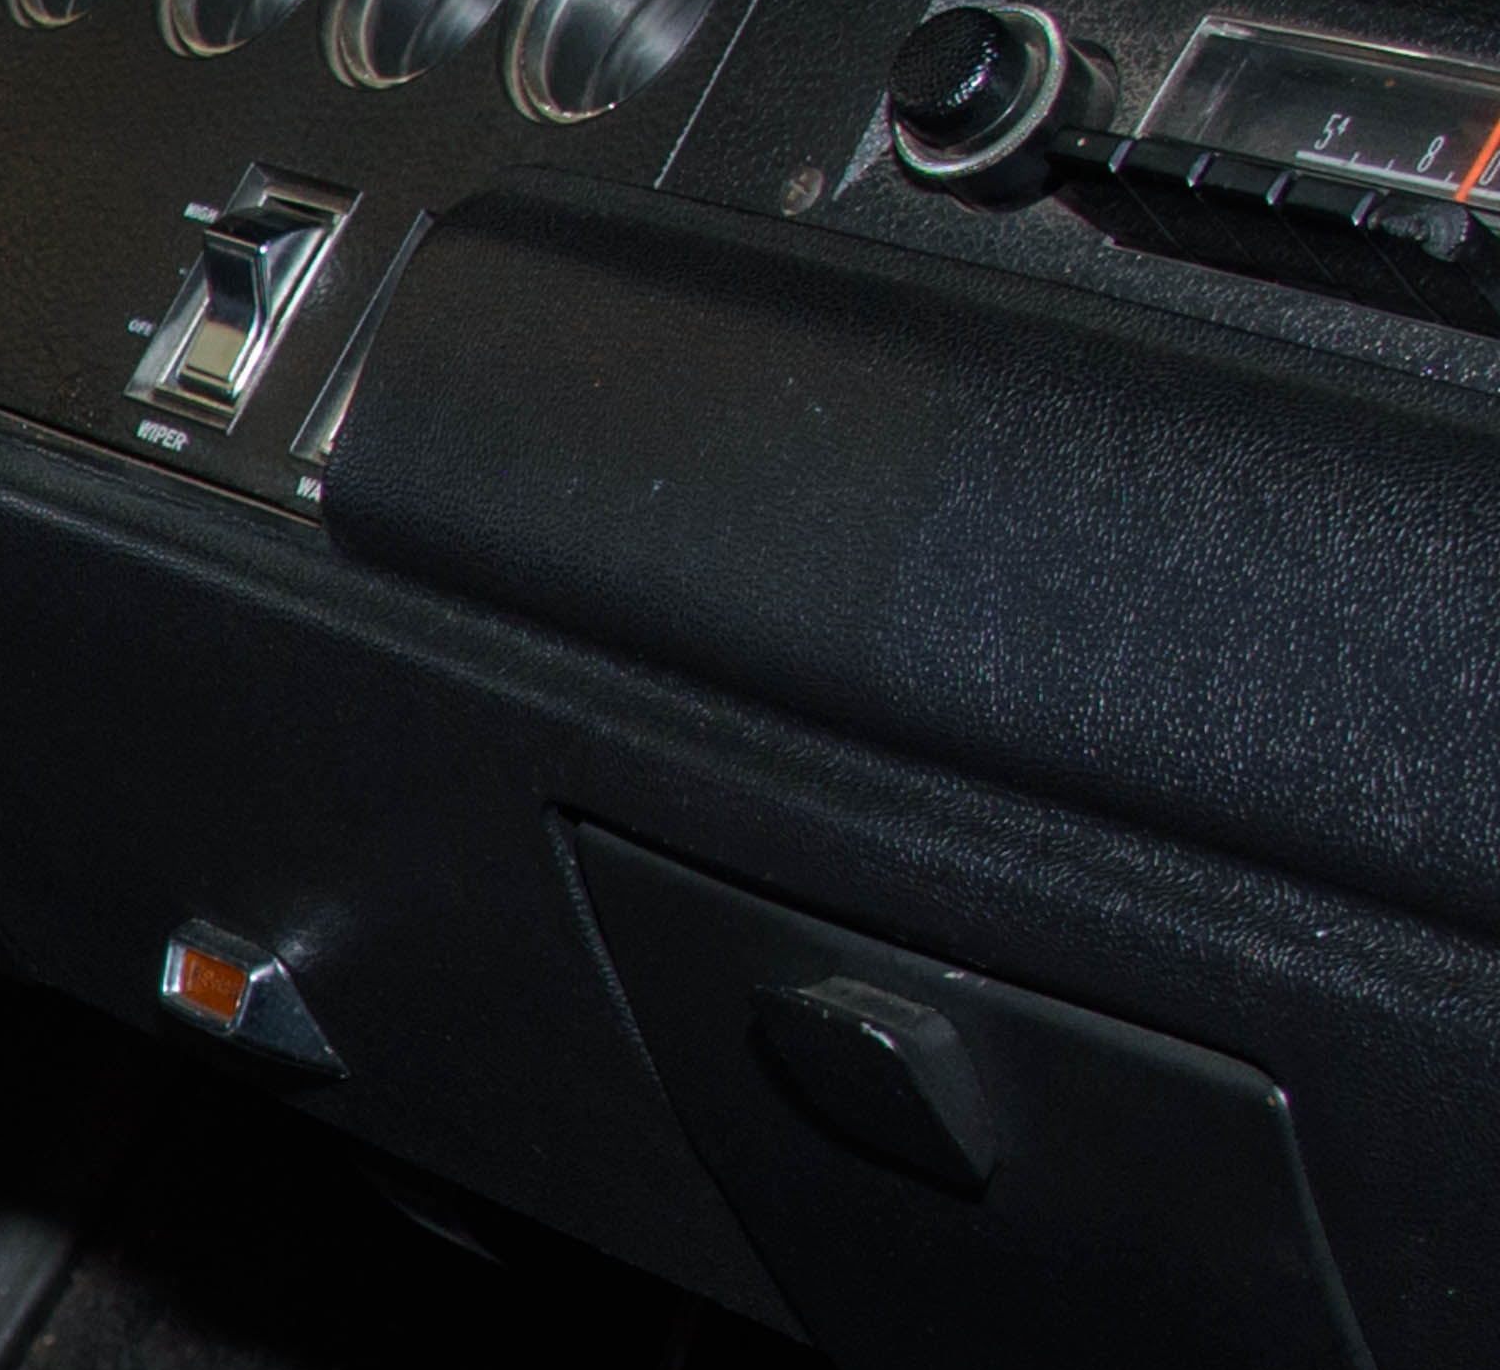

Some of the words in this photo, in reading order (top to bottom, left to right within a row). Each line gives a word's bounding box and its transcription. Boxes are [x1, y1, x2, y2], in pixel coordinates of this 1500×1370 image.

[1415, 135, 1446, 173] 8
[136, 418, 190, 453] WIPER
[296, 475, 324, 503] WA
